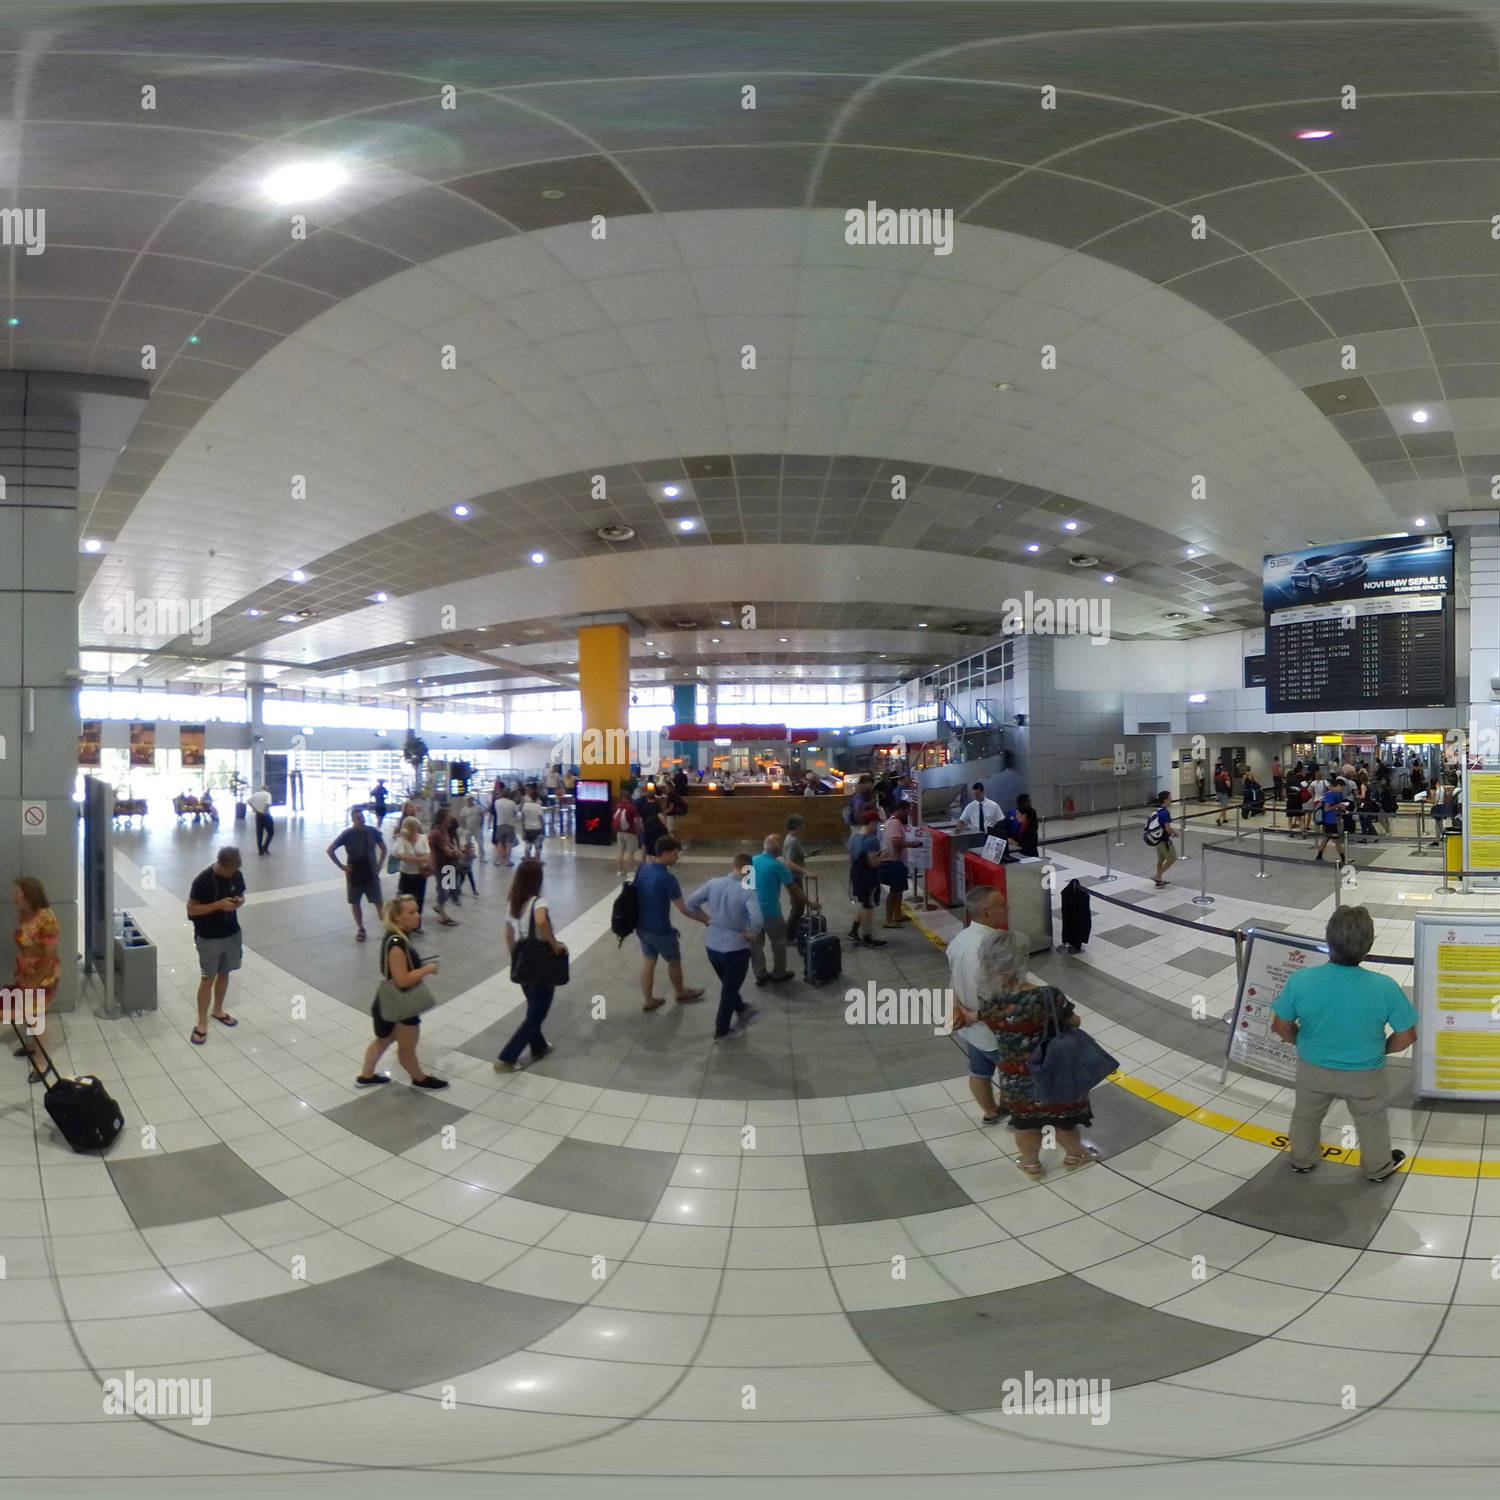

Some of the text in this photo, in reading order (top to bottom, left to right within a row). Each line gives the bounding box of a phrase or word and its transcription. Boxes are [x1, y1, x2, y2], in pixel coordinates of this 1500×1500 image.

[1363, 580, 1384, 590] NOVI
[1385, 578, 1407, 588] BMW
[1408, 576, 1439, 586] SERIJE
